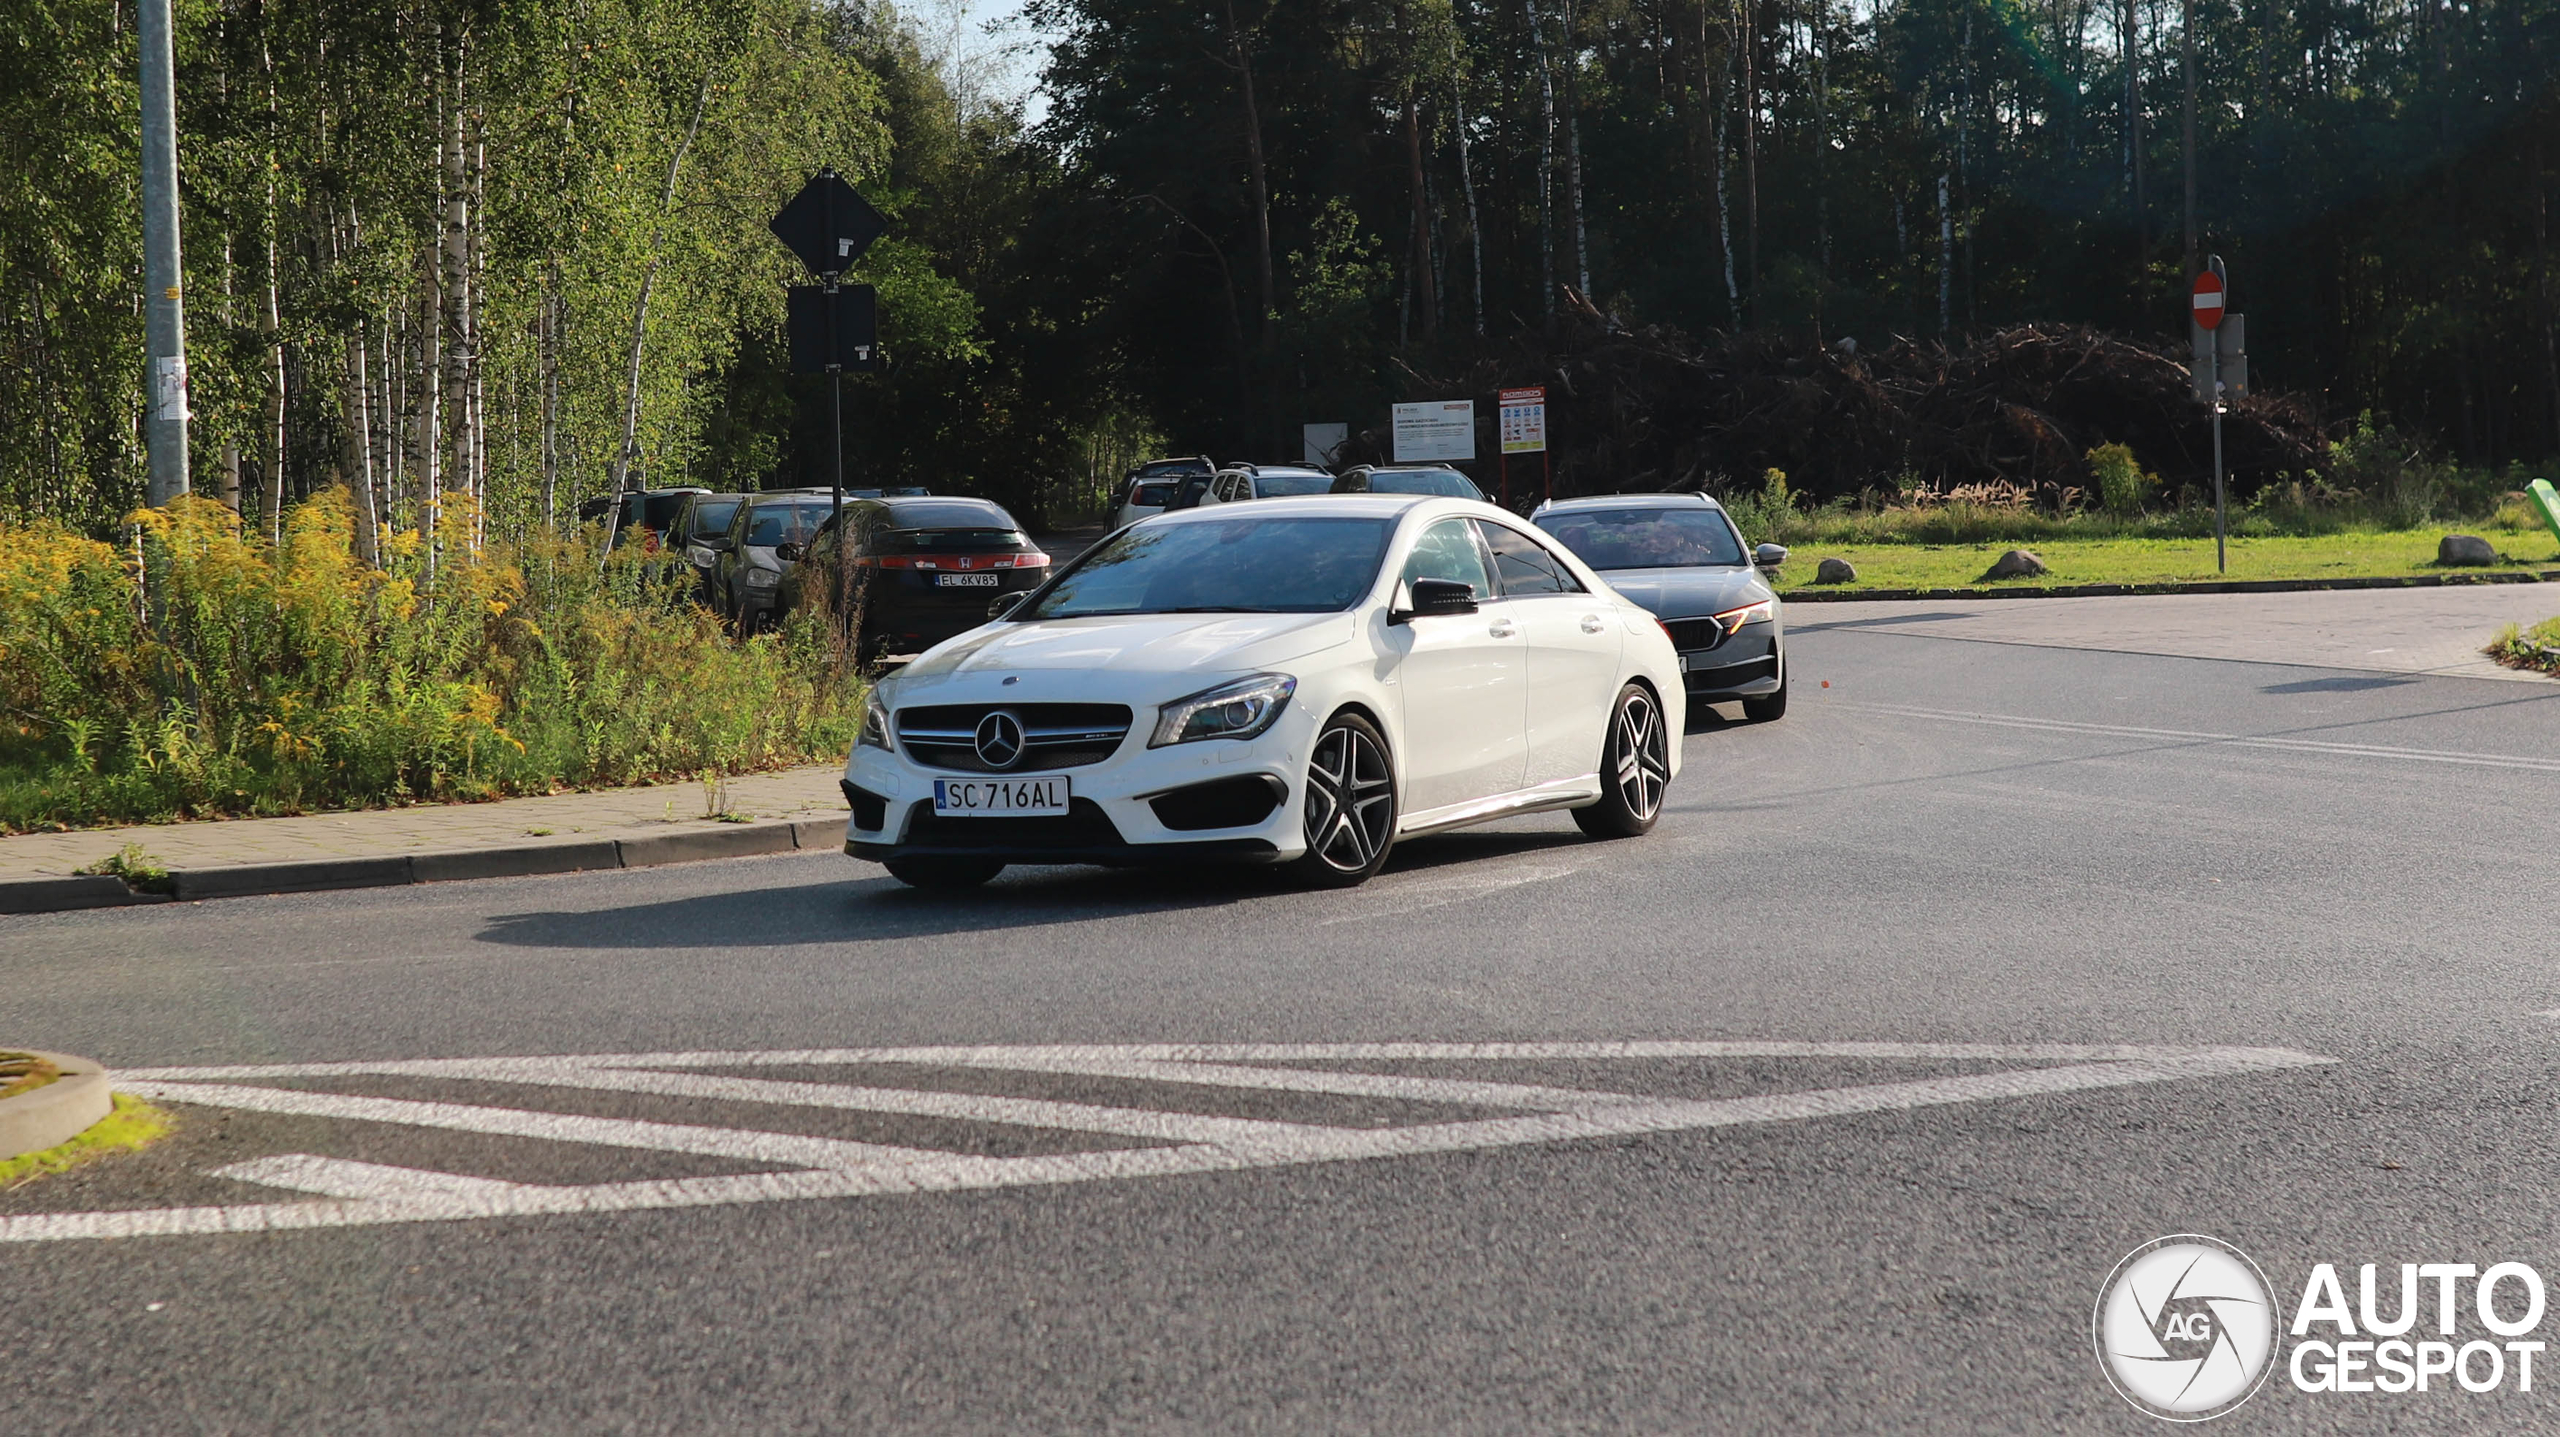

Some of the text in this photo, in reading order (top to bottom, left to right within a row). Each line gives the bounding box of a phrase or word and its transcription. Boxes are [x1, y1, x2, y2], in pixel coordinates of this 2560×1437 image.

[942, 575, 956, 586] EL
[961, 575, 996, 586] 6KV85
[949, 782, 1063, 808] SC 716AL
